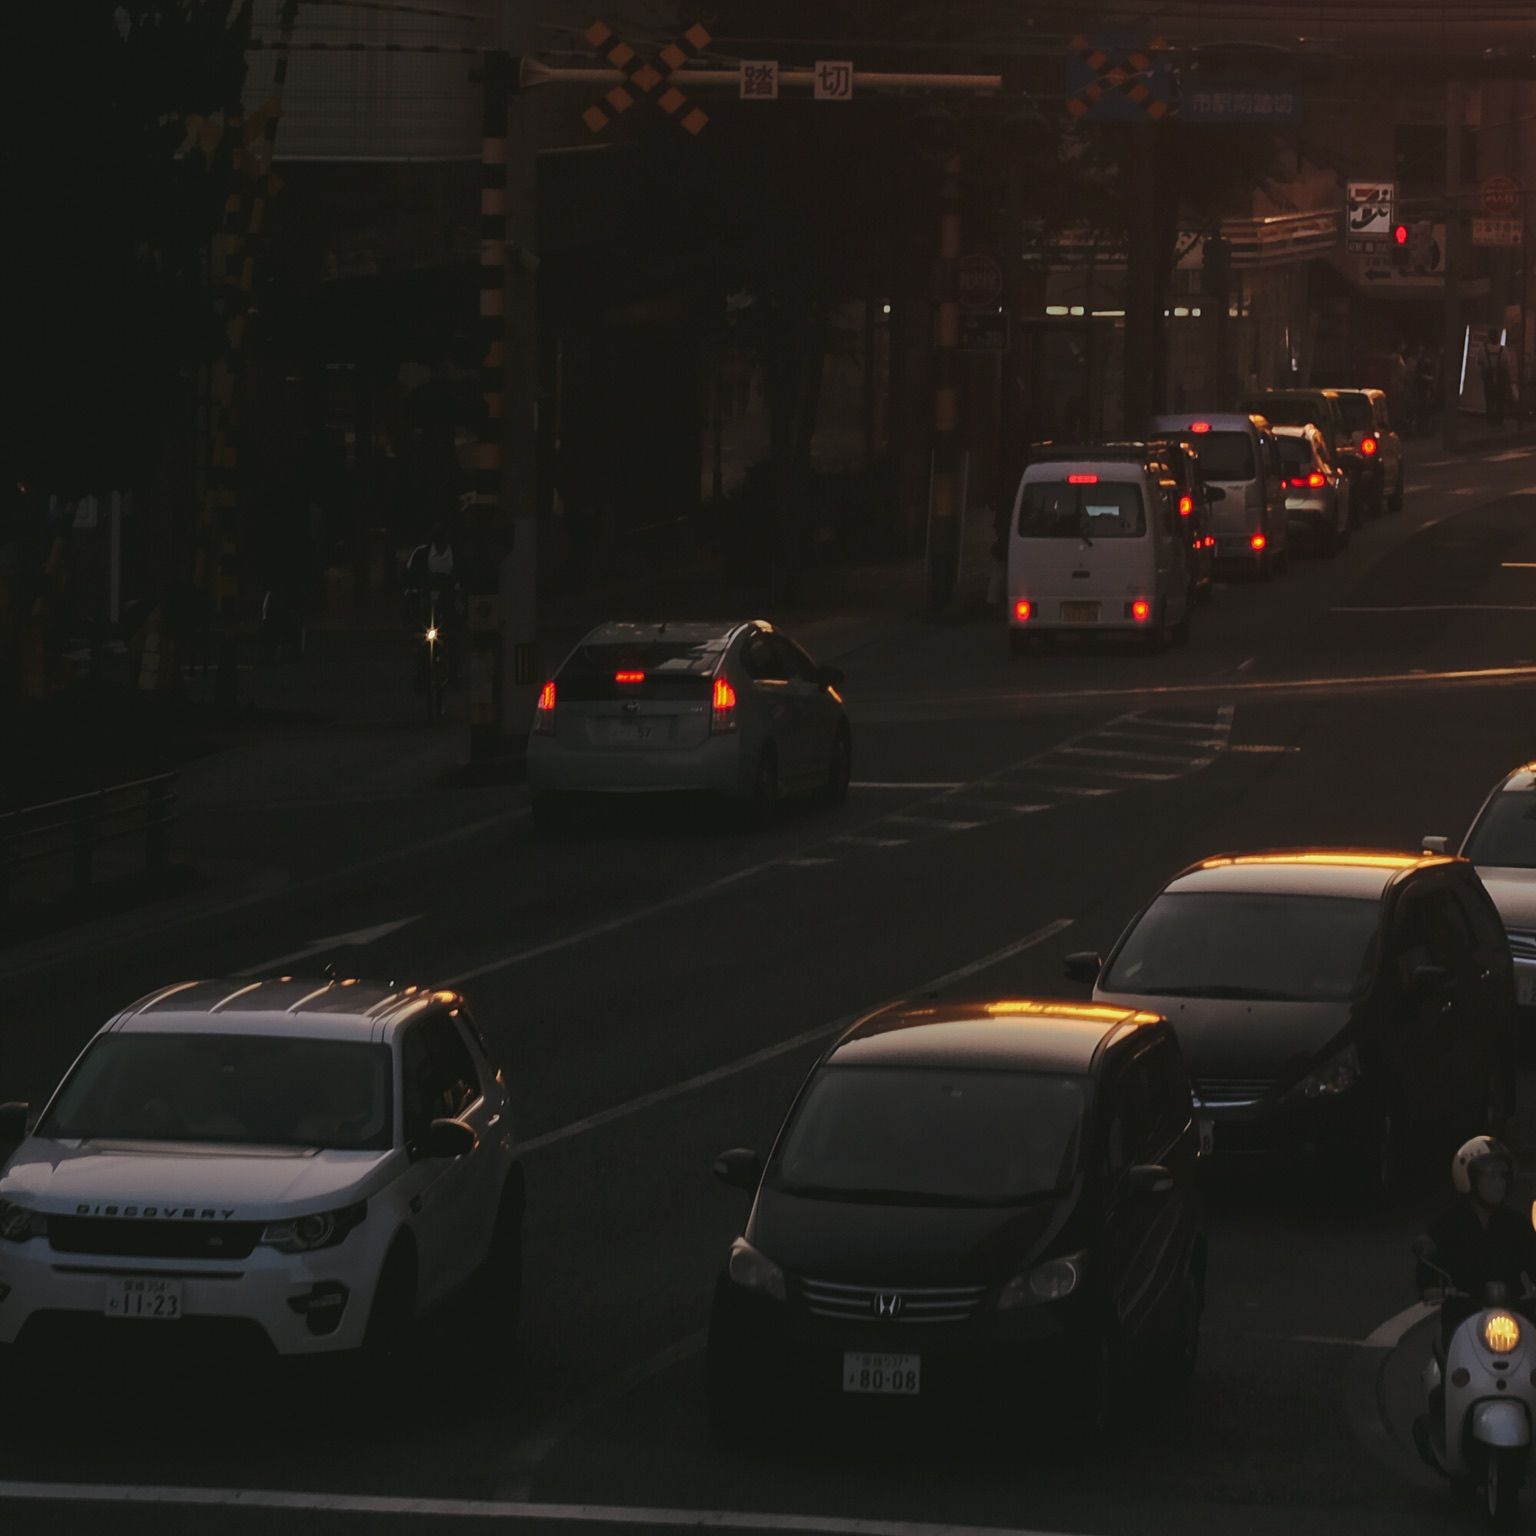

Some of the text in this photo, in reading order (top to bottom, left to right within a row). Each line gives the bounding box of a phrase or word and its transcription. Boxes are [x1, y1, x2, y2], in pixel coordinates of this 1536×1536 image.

[75, 1204, 236, 1220] DISCOVERY
[123, 1293, 178, 1316] 11-23
[859, 1368, 917, 1391] 80-08
